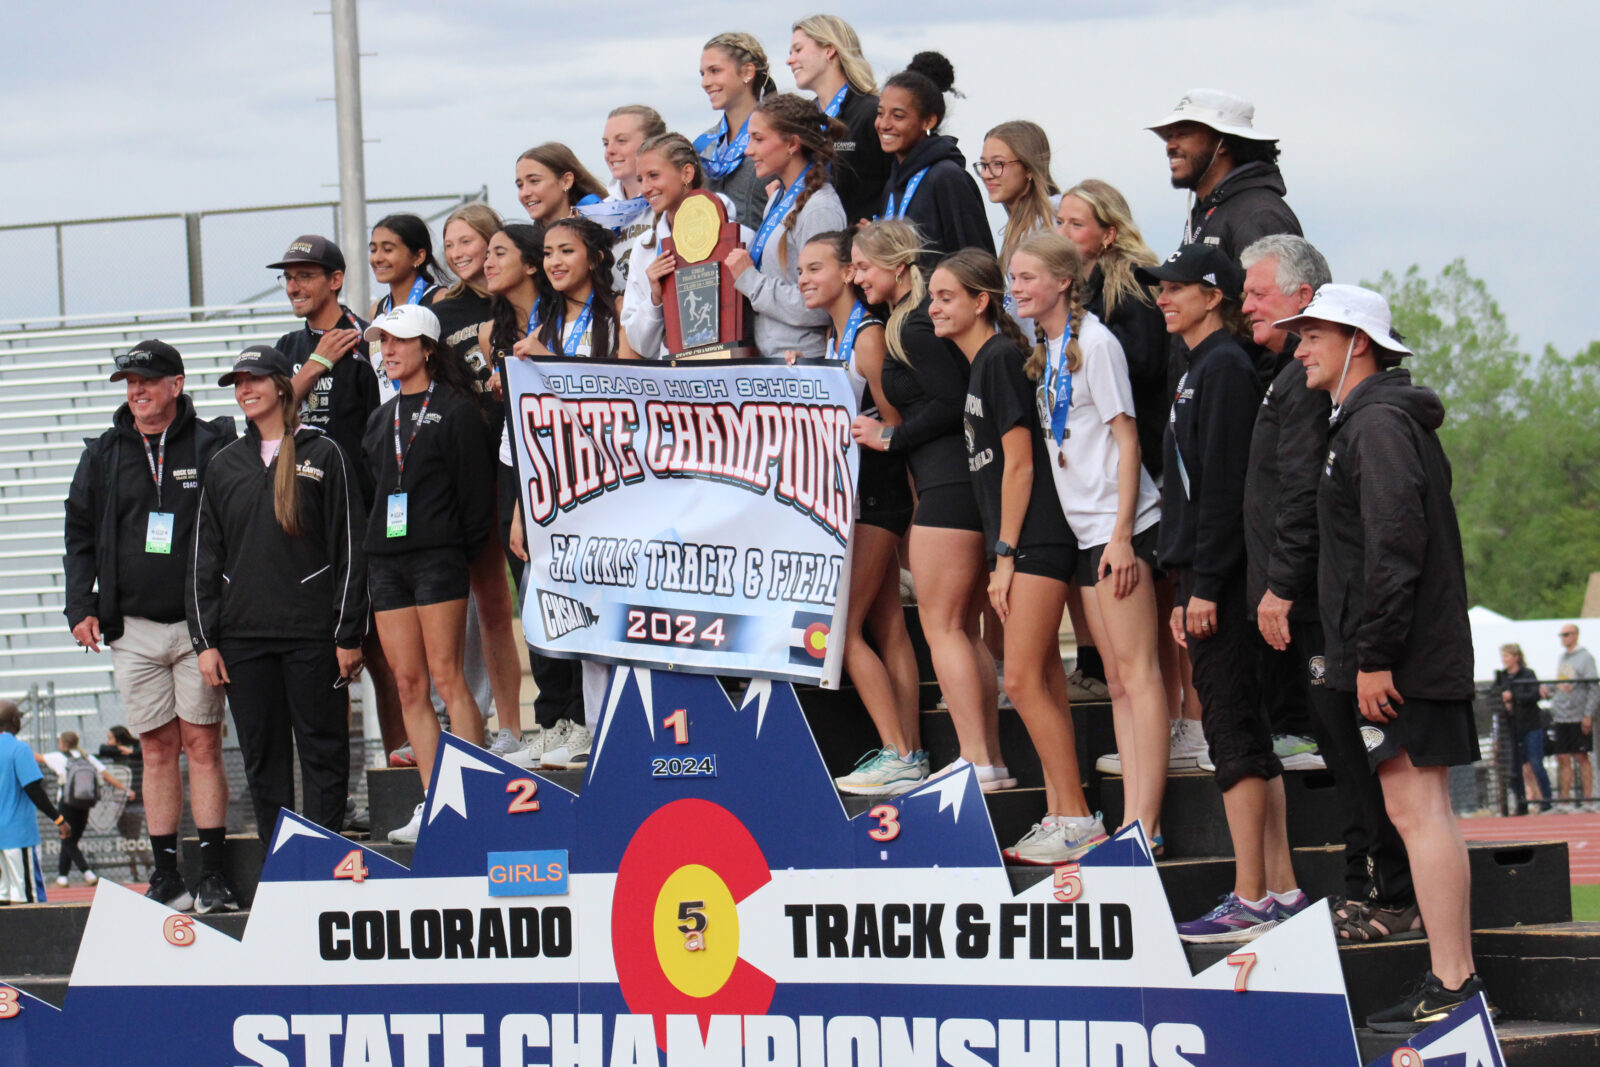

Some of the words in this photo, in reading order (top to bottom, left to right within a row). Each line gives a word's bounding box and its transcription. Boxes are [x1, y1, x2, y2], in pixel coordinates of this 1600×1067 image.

[1168, 251, 1182, 262] C
[664, 378, 728, 398] HIGH
[736, 378, 829, 400] SCHOOL
[519, 393, 643, 528] STATE
[644, 400, 853, 549] CHAMPIONS
[549, 534, 577, 583] 5A
[579, 537, 640, 587] GIRLS
[645, 541, 736, 597] TRACK
[743, 547, 764, 599] &
[769, 552, 845, 606] FIELD
[626, 610, 726, 647] 2024
[663, 708, 689, 745] 1
[651, 757, 714, 777] 2024
[505, 777, 540, 814] 2
[868, 804, 901, 842] 3
[333, 849, 369, 883] 4
[489, 862, 563, 885] GIRLS
[1053, 863, 1083, 902] 5
[163, 913, 195, 946] 6
[318, 905, 573, 961] COLORADO
[677, 900, 708, 935] 5
[784, 903, 946, 960] TRACK
[955, 903, 991, 960] &
[999, 902, 1134, 961] FIELD
[684, 930, 706, 952] a
[1227, 952, 1257, 992] 7
[233, 1013, 485, 1067] STATE
